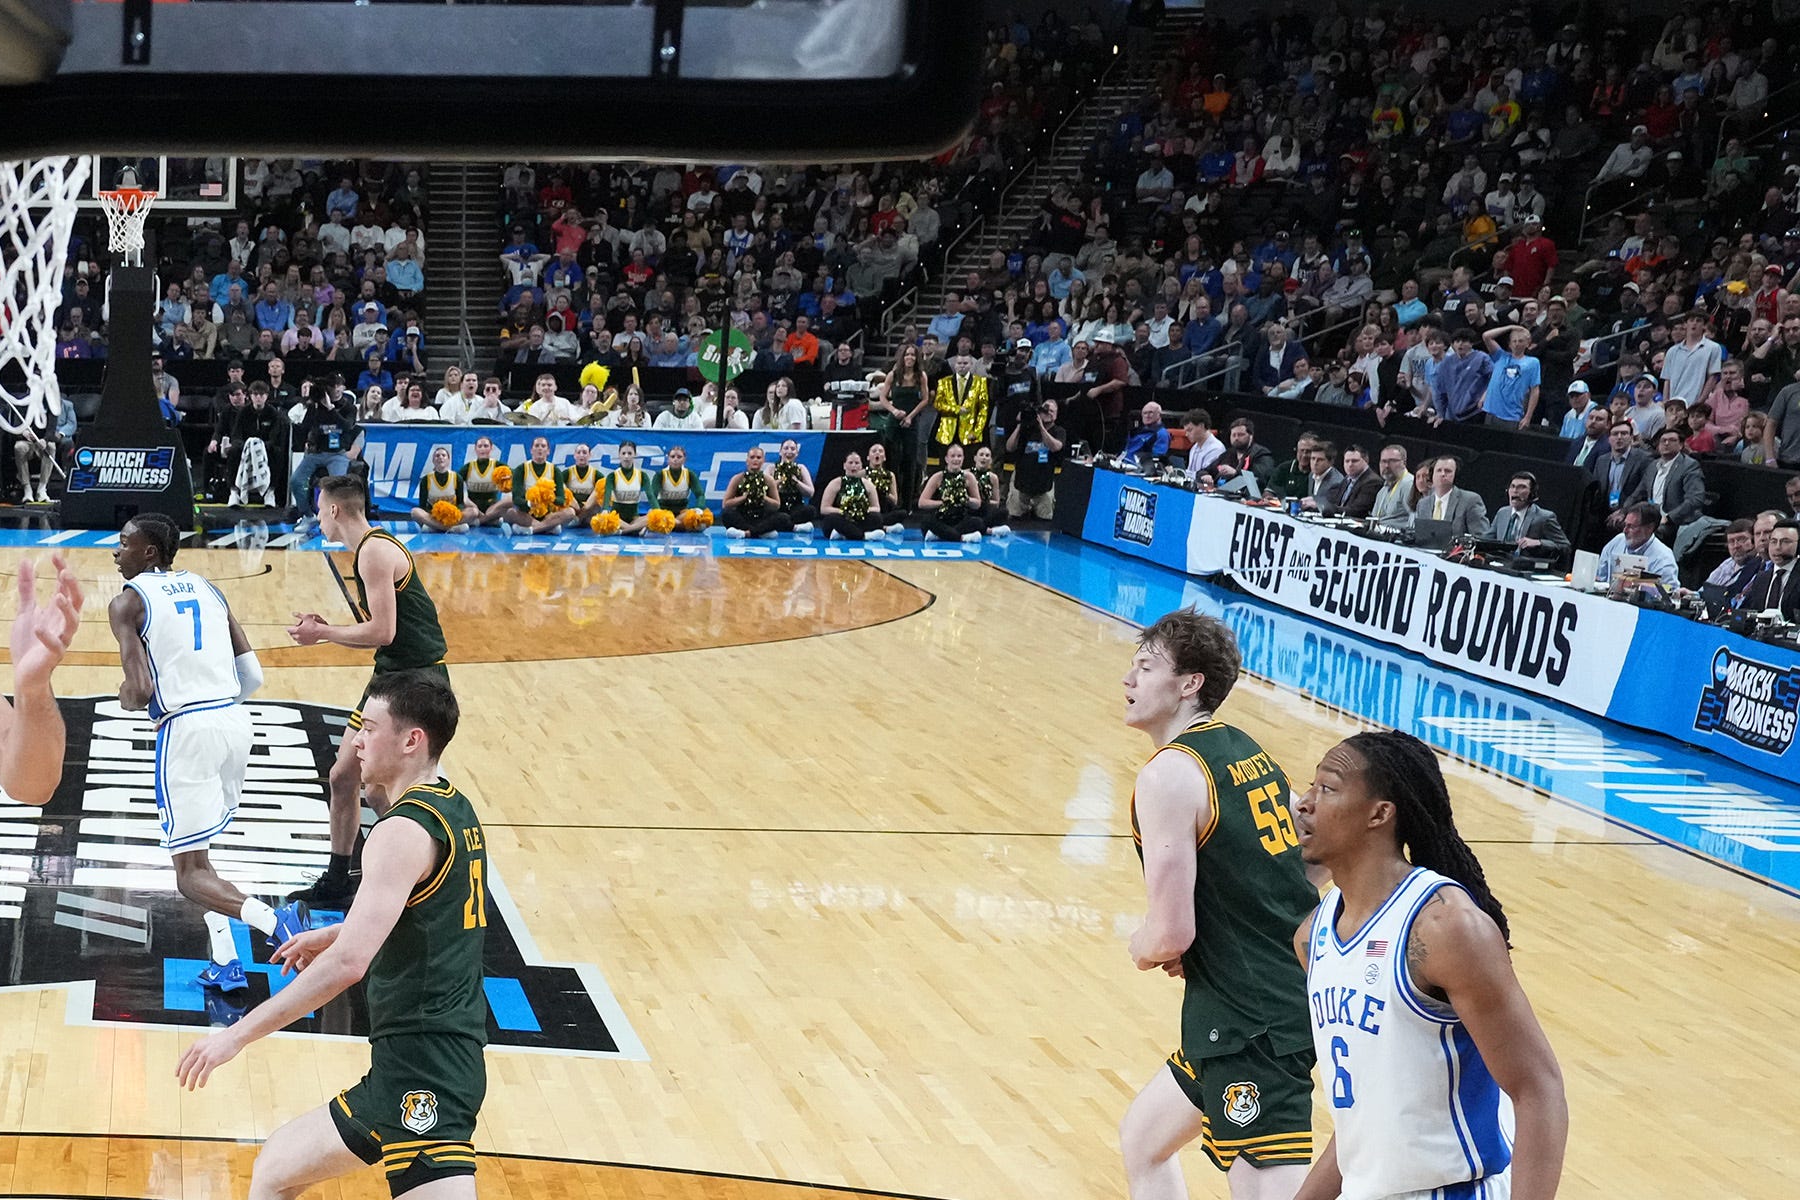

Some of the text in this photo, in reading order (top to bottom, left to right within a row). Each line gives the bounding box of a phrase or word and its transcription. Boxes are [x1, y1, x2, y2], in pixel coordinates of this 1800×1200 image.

[93, 451, 146, 468] MARCH
[98, 468, 170, 485] MADNESS
[728, 545, 963, 557] ROUND
[161, 582, 196, 595] SARR
[1229, 512, 1578, 686] FIRST AND SECOND ROUNDS
[174, 599, 202, 651] 7
[1726, 659, 1777, 702] MARCH
[1725, 693, 1796, 743] MADNESS
[1247, 780, 1299, 856] 55
[1312, 987, 1385, 1036] DUKE
[1331, 1036, 1355, 1109] 6
